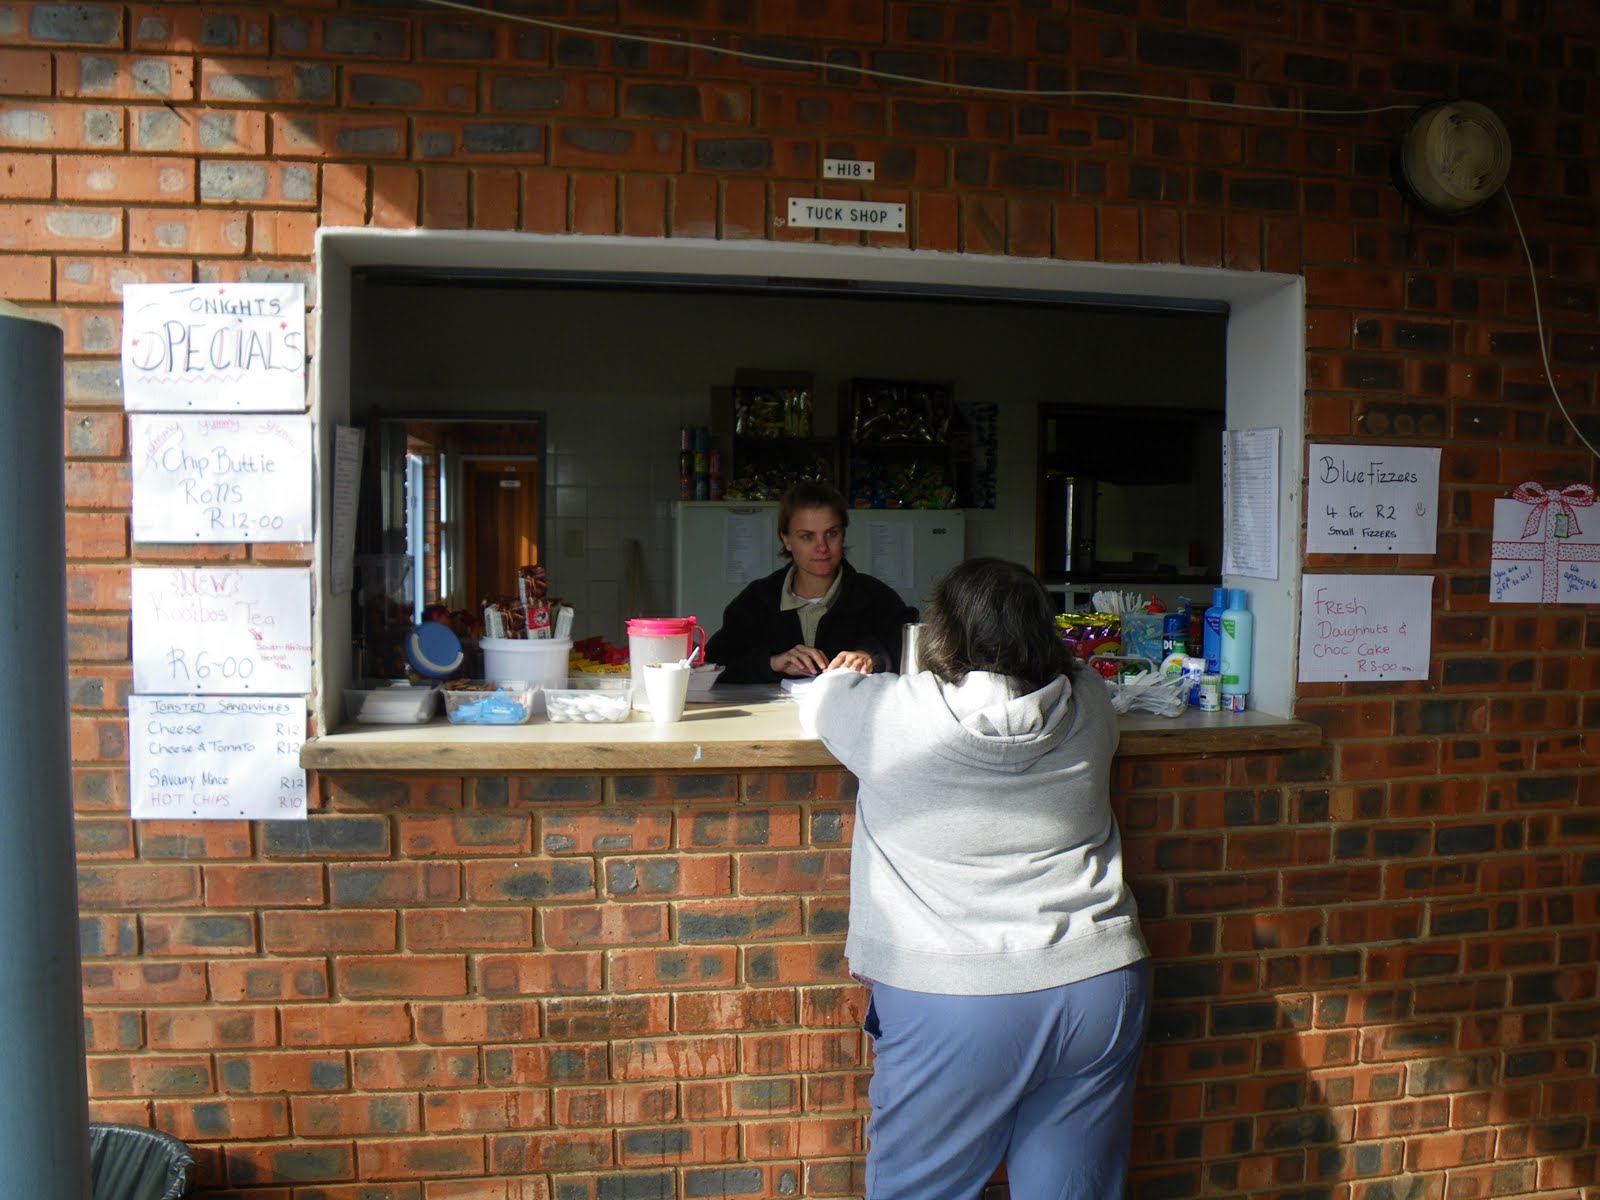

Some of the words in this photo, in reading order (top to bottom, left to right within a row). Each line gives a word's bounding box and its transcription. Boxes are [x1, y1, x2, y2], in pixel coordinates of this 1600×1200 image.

[837, 163, 861, 177] H18
[805, 206, 843, 221] TUCK
[850, 208, 888, 223] SHOP
[131, 319, 304, 374] SPECIALS
[161, 446, 209, 478] Chip
[211, 445, 275, 475] Buttie
[1326, 504, 1338, 519] 4
[1376, 504, 1397, 520] R2
[1327, 525, 1355, 537] Small
[235, 599, 276, 626] Tea
[1317, 620, 1389, 643] Doughnuts
[1313, 642, 1349, 658] Choc
[1357, 642, 1391, 657] Cake
[149, 699, 206, 714] TOASTED
[147, 720, 203, 736] Cheese
[275, 722, 300, 737] R12
[149, 742, 193, 756] Cheese
[197, 743, 207, 752] &
[276, 742, 300, 755] R12
[280, 777, 305, 789] R12
[151, 792, 186, 807] HOT
[193, 793, 231, 808] CHIPS
[277, 796, 303, 809] R10
